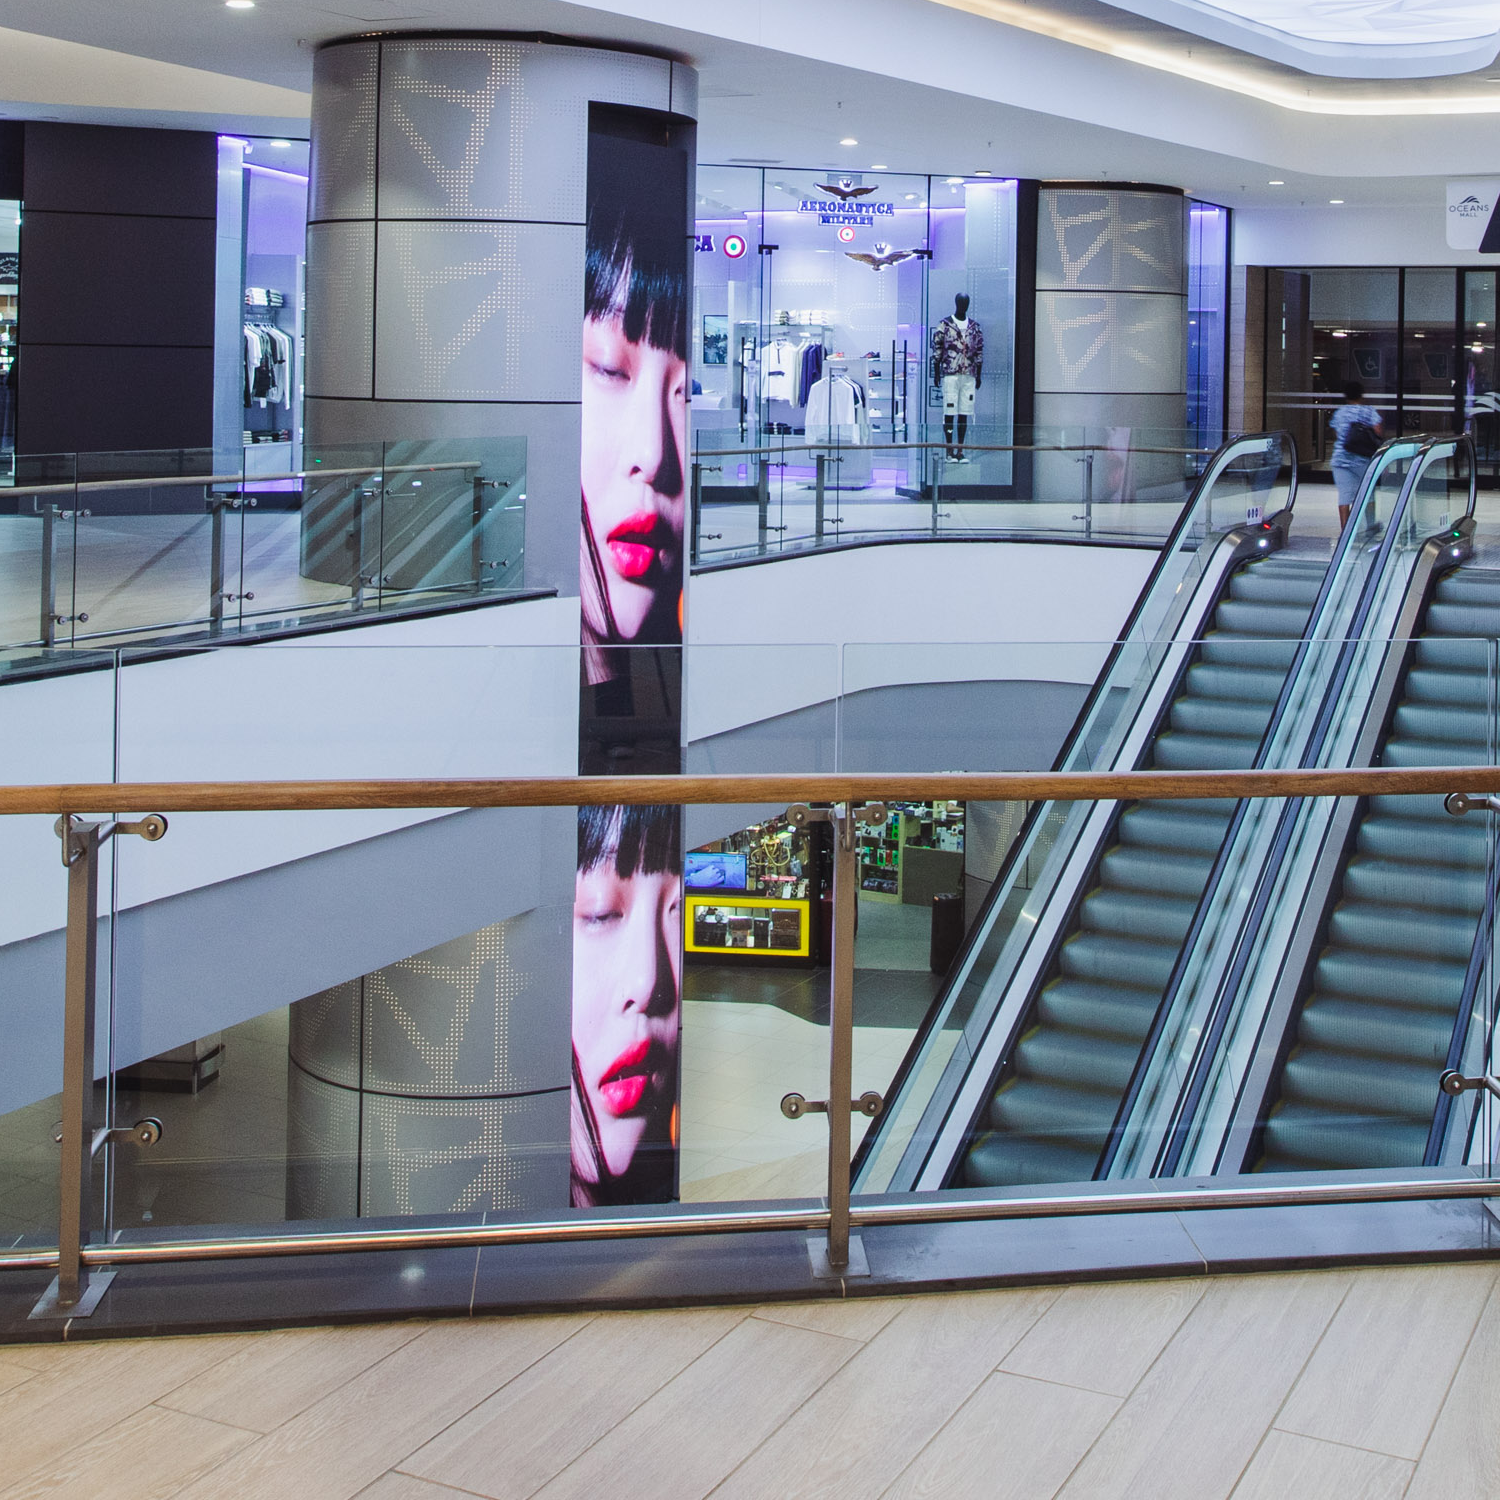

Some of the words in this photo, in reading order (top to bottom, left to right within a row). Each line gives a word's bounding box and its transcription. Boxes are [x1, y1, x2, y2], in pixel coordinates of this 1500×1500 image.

[799, 200, 894, 215] AERONAUTICA
[1449, 204, 1489, 213] OCEANS
[820, 215, 873, 225] MILITARE
